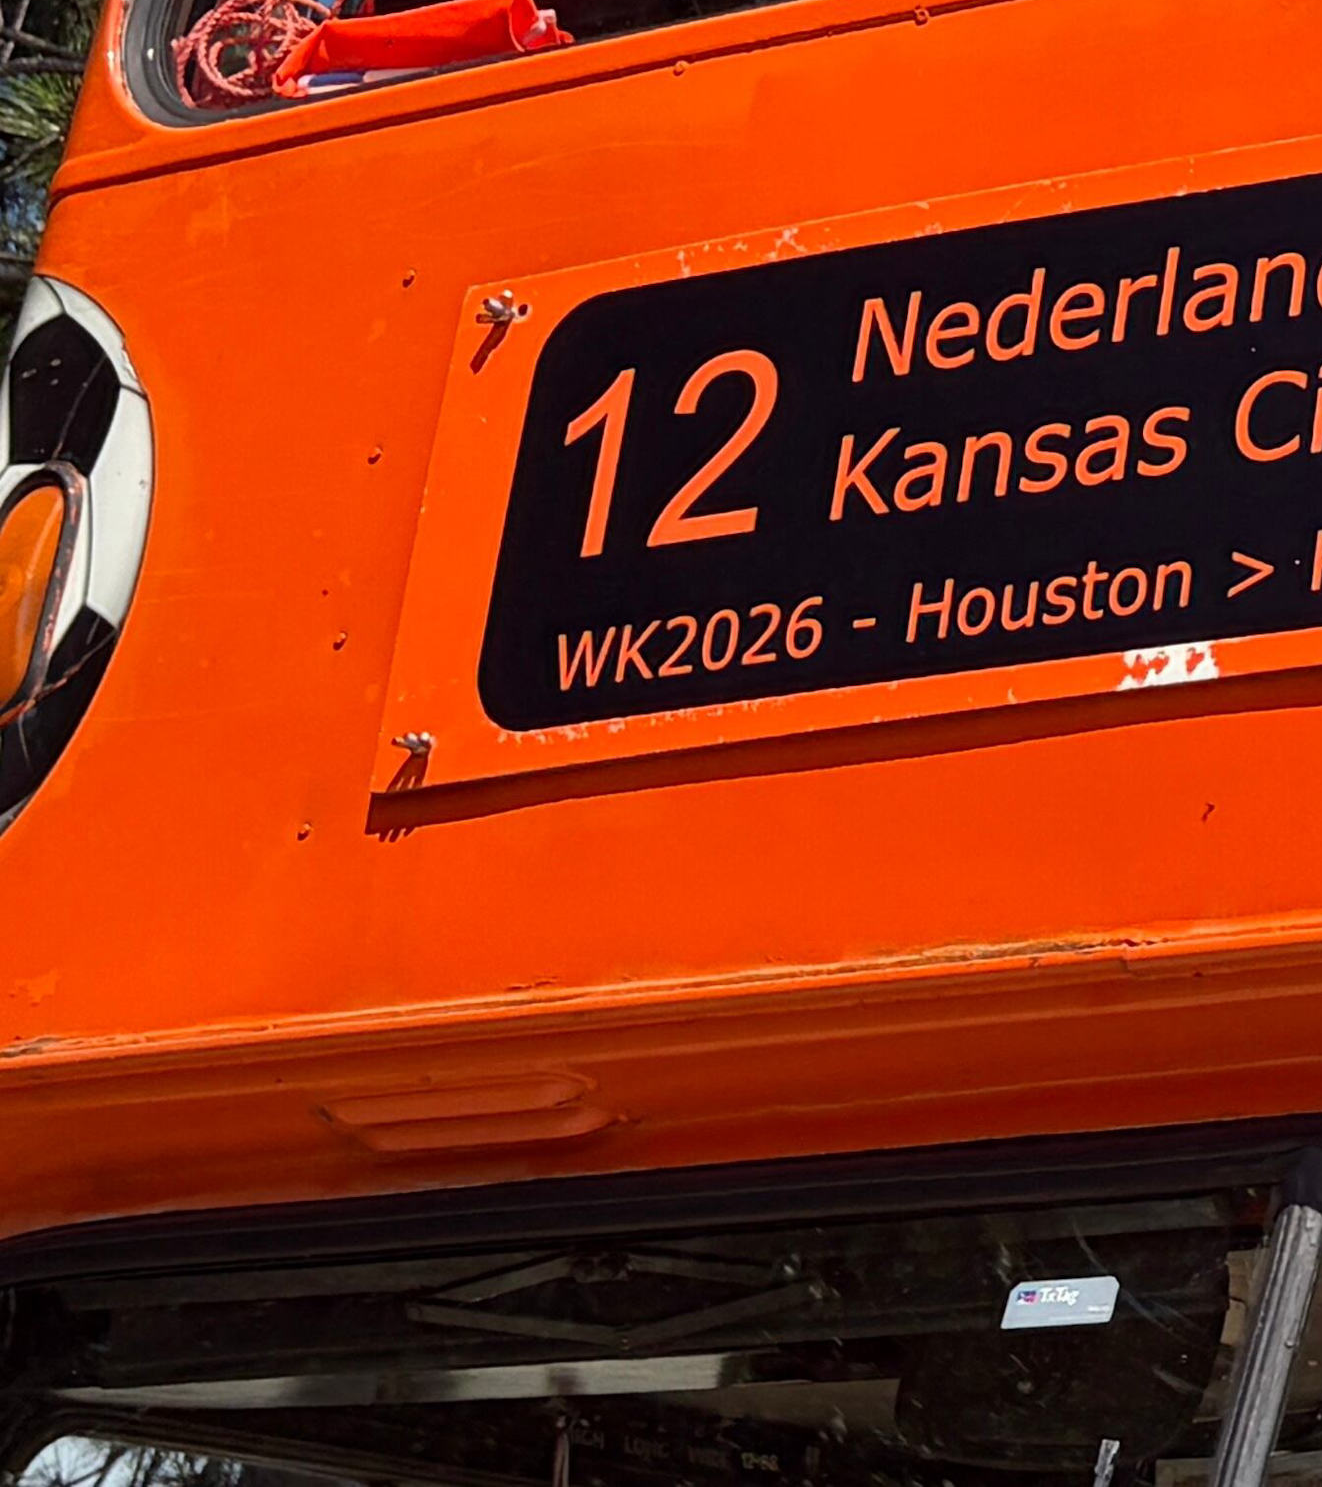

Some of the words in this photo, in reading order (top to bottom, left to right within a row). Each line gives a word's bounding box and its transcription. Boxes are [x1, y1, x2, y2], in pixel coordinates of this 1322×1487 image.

[563, 349, 780, 559] 12
[828, 406, 1190, 521] Kansas
[557, 596, 823, 691] WK2026
[852, 617, 877, 630] -
[905, 560, 1192, 643] Houston
